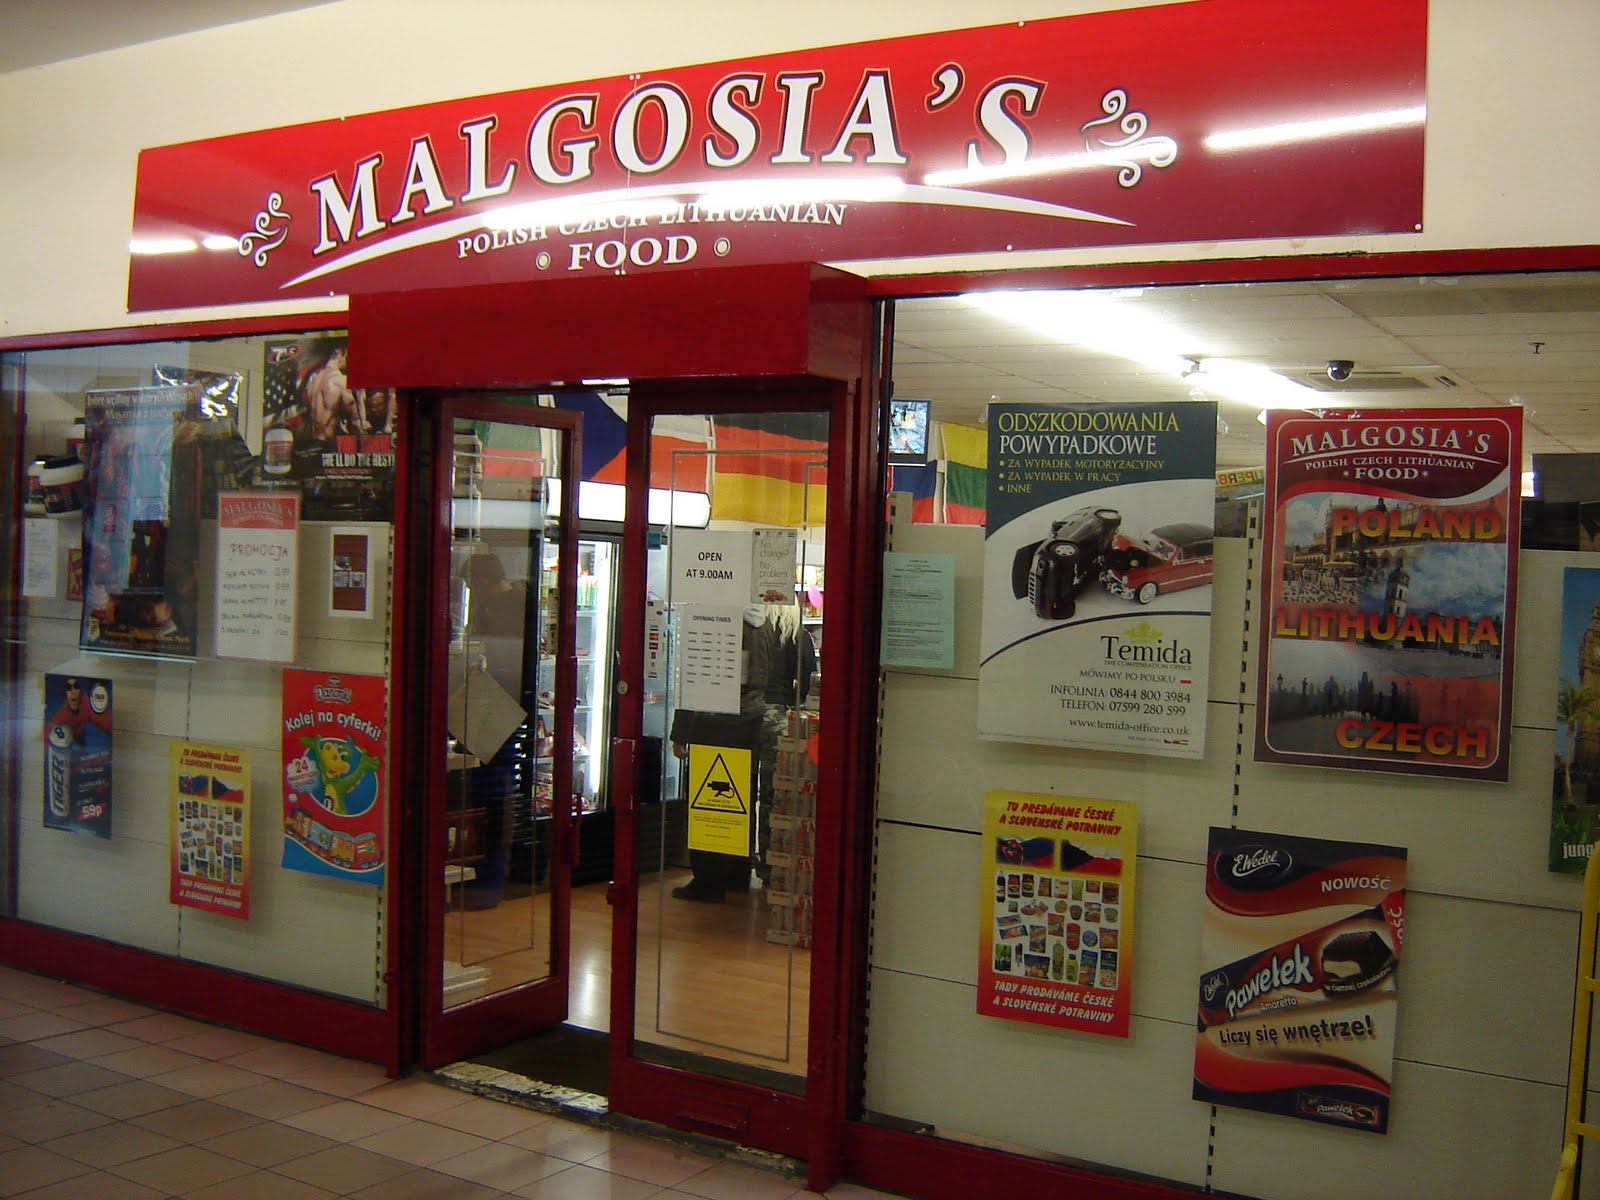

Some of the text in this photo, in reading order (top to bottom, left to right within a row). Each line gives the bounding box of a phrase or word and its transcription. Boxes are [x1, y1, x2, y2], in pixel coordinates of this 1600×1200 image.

[310, 66, 1044, 256] MALGOSIA'S
[457, 201, 847, 259] POLISH CZECH LITHUANIAN
[567, 234, 698, 272] FOOD
[998, 411, 1180, 432] ODSZKODOWANIA
[1000, 435, 1157, 455] POWYPADKOWE
[1290, 425, 1491, 457] MALGOSIA'S
[1008, 459, 1165, 471] ZA WYPADEK MOTORYZACYJNY
[1305, 456, 1475, 470] POLISH CZECH LITHUANIAN
[1007, 472, 1121, 482] ZA WYPADEK W PRACY
[1354, 467, 1419, 480] FOOD
[1007, 484, 1031, 493] INNE
[1334, 507, 1500, 540] POLAND
[698, 551, 722, 562] OPEN
[686, 569, 733, 580] AT 9.00AM
[693, 615, 714, 623] OPENING
[1275, 608, 1500, 646] LITHUANIA
[1101, 635, 1192, 664] Temida
[1080, 668, 1122, 679] MÓWIMY
[1140, 673, 1176, 683] POLSKU
[1051, 684, 1190, 703] INFOLINIA: 0844 800 3984
[1060, 698, 1185, 716] TELEFON: 07599 280 599
[286, 709, 382, 741] Kolej na cyferki!
[1335, 718, 1488, 758] CZECH
[82, 803, 102, 819] 59p
[1006, 801, 1019, 812] TU
[1083, 806, 1115, 821] ČESKÉ
[999, 814, 1122, 836] A SLOVENSKÉ POTRAVINY
[1321, 874, 1392, 892] NOWOŚĆ
[1225, 942, 1314, 1021] Pawełek
[994, 980, 1019, 994] TADY
[1082, 991, 1115, 1008] ČESKÉ
[1259, 995, 1297, 1012] Amaretto
[992, 995, 1115, 1023] A SLOVENSKÉ POTRAVINY
[1219, 1015, 1374, 1046] Liczy się wnętrze!
